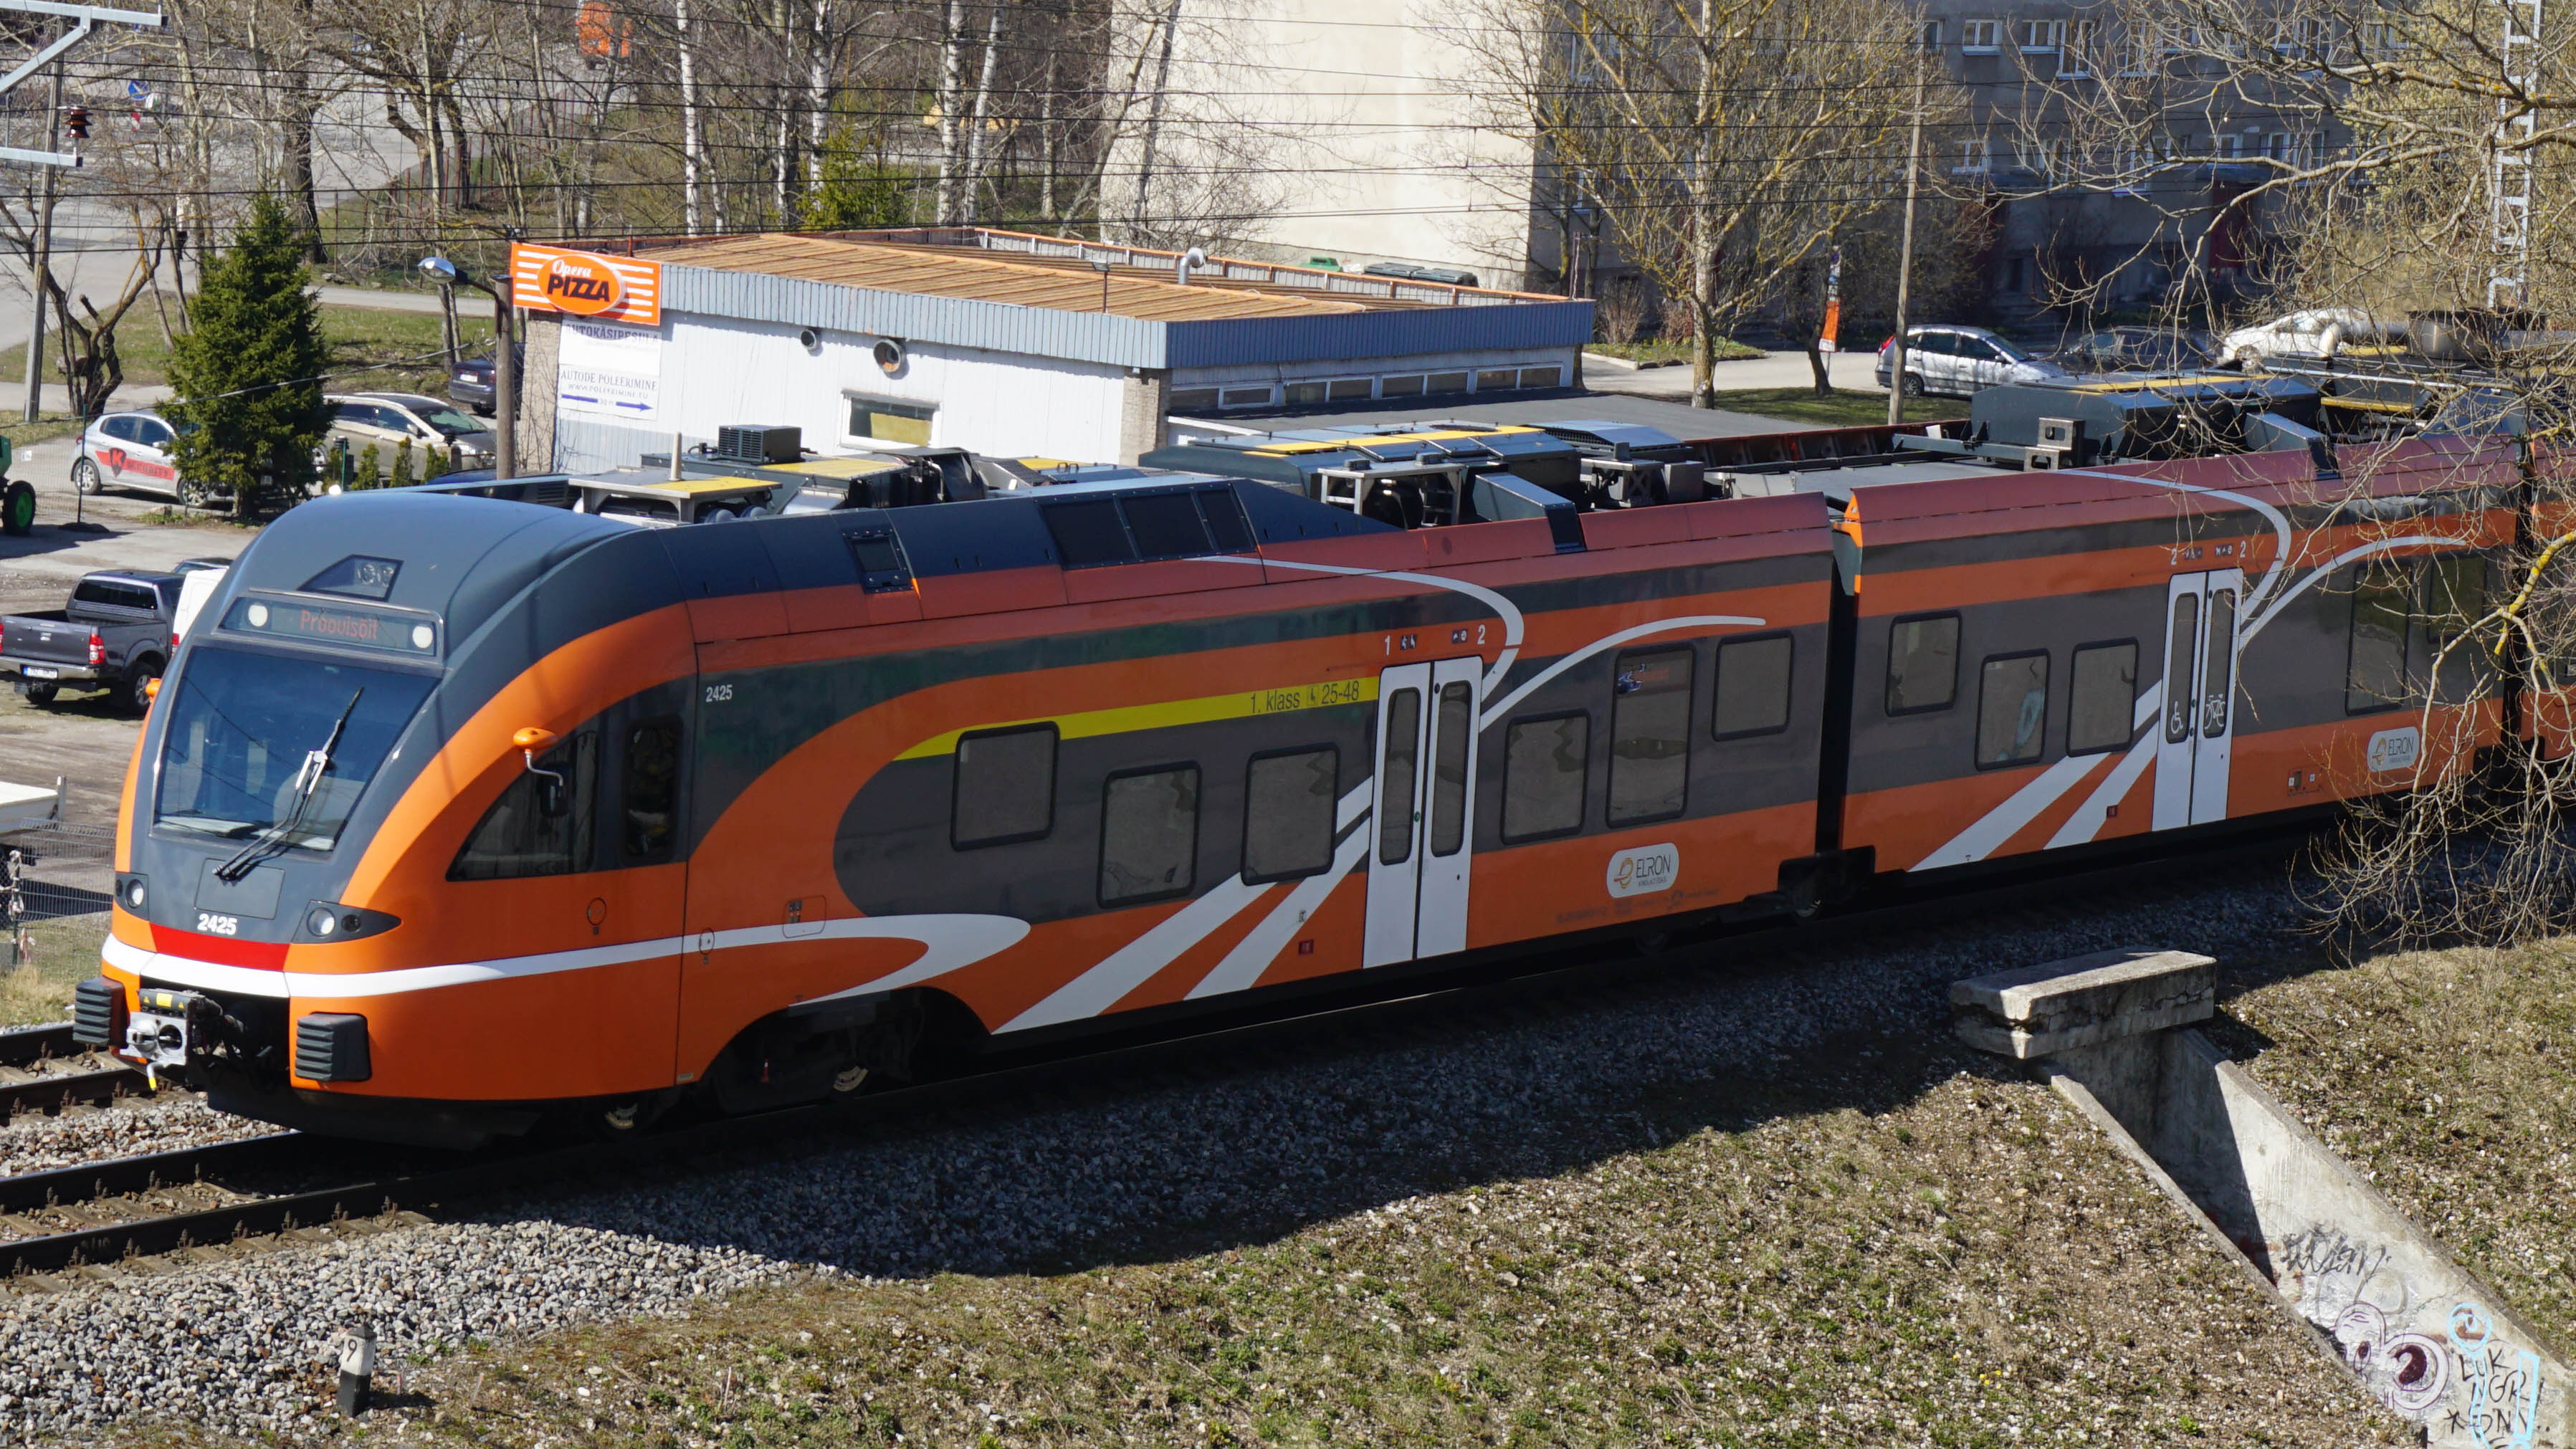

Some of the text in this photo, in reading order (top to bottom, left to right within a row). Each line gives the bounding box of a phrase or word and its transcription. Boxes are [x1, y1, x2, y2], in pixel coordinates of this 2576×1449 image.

[552, 259, 592, 277] Opera
[547, 274, 610, 302] PIZZA
[560, 370, 657, 391] AUTODE POLEERIMINE
[2170, 547, 2177, 565] 2
[2239, 540, 2247, 558] 2
[1477, 624, 1486, 645] 2
[1384, 635, 1391, 656] 1
[705, 684, 733, 703] 2425
[1266, 689, 1301, 712] klass
[1321, 680, 1360, 704] 25-48
[2387, 736, 2415, 756] ELRON
[1636, 853, 1671, 879] ELRON
[197, 912, 238, 935] 2425
[347, 1338, 358, 1362] 9
